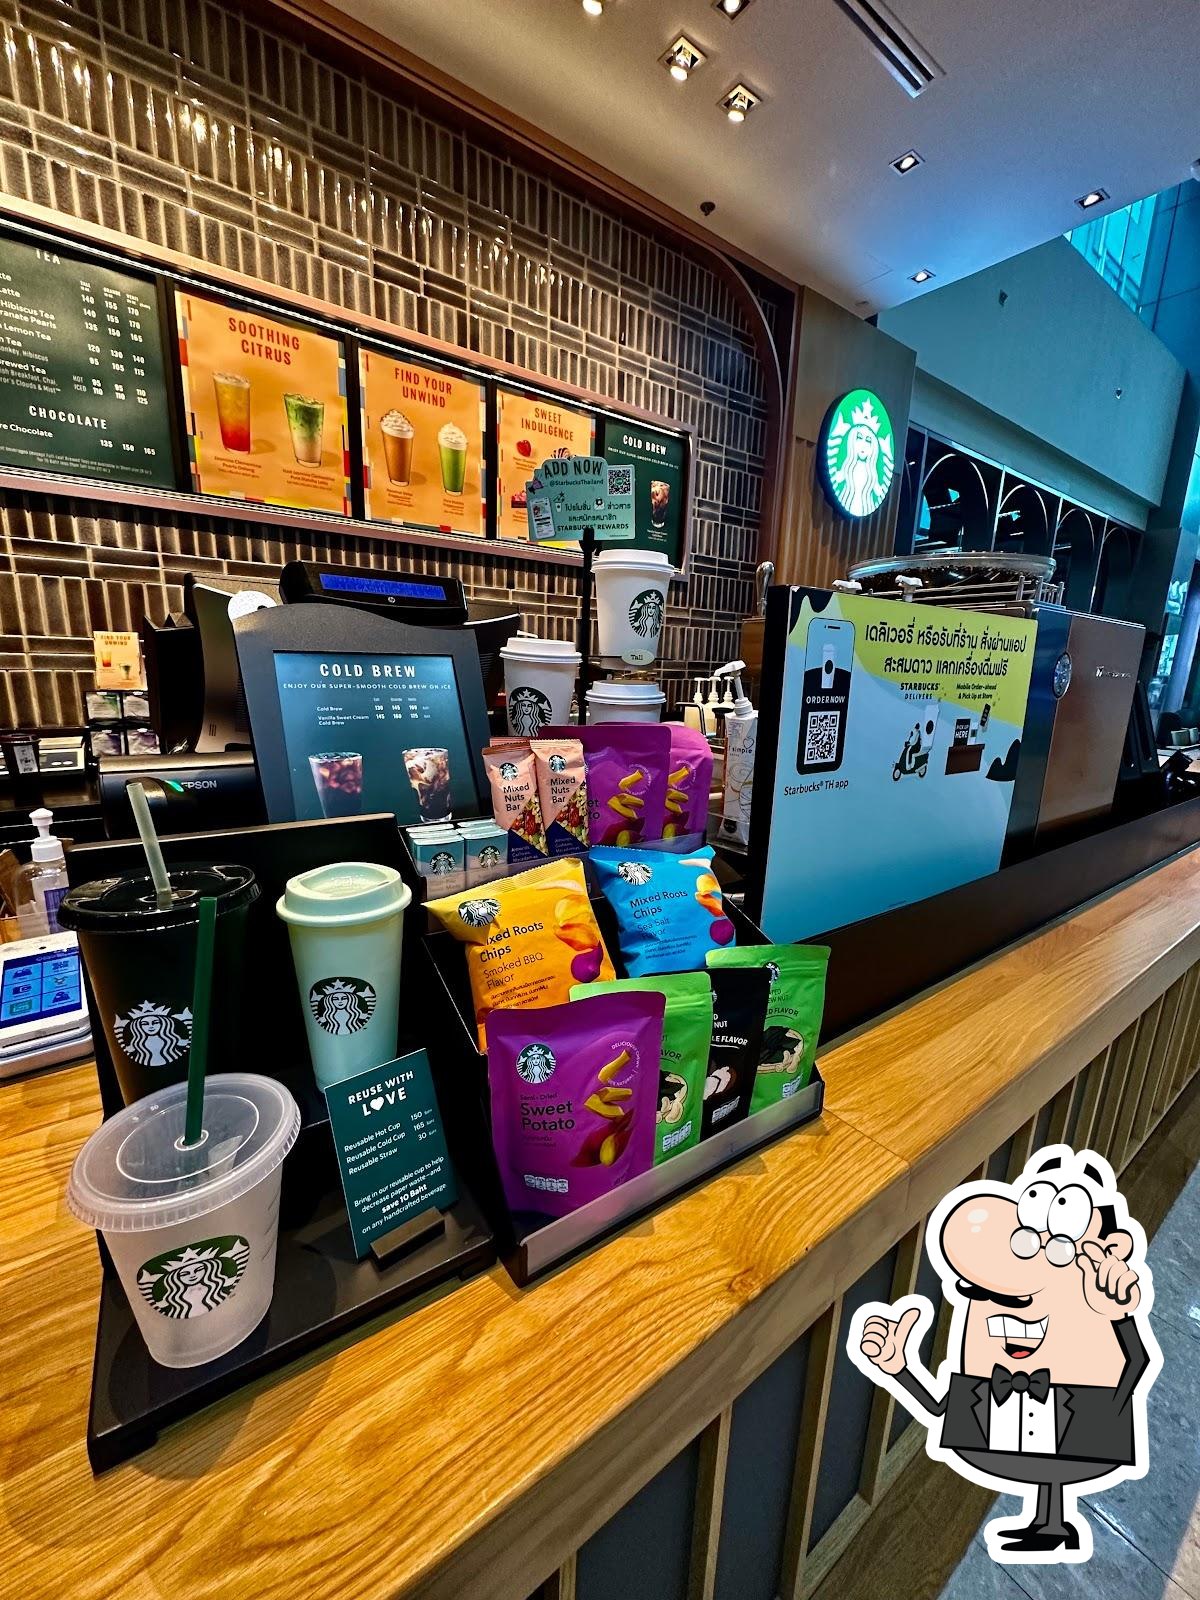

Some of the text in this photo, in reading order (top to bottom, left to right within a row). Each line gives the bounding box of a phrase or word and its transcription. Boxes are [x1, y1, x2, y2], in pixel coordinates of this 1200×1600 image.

[1, 300, 140, 329] Hibiscus Tea 140 155 170
[81, 294, 94, 304] 140
[105, 301, 117, 310] 155
[128, 307, 139, 316] 170
[31, 316, 143, 343] Pearls 135 150 165
[229, 317, 300, 350] SOOTHING
[4, 323, 34, 337] Lemon
[35, 331, 52, 341] Tea
[88, 344, 100, 353] 120
[133, 355, 144, 364] 140
[241, 339, 291, 365] CITRUS
[5, 337, 22, 347] Tea
[112, 363, 124, 372] 105
[134, 368, 144, 376] 115
[31, 365, 46, 375] Tea
[394, 368, 452, 395] FIND YOUR
[93, 387, 103, 395] 110
[115, 392, 125, 400] 110
[402, 386, 446, 408] UNWIND
[29, 405, 107, 430] CHOCOLATE
[534, 407, 562, 424] SWEET
[9, 423, 54, 438] Chocolate
[144, 447, 155, 455] 165
[521, 418, 574, 442] INDULGENCE
[623, 435, 667, 455] COLD BREW
[544, 461, 568, 479] ADD
[573, 459, 603, 476] NOW
[319, 663, 416, 678] COLD BREW
[955, 731, 969, 739] HERE
[503, 782, 530, 793] Mixed
[550, 776, 576, 786] Mixed
[551, 786, 570, 795] Nuts
[825, 780, 835, 790] TH
[835, 779, 849, 789] app
[504, 793, 525, 802] Nuts
[506, 803, 521, 812] Bar
[552, 796, 566, 804] Bar
[630, 890, 688, 908] Mixed Roots
[633, 905, 662, 919] Chips
[486, 922, 544, 945] ixed Roots
[480, 945, 511, 962] Chips
[483, 952, 544, 978] Smoked BBQ
[486, 974, 514, 989] Flavor
[774, 1007, 799, 1016] FLAVOR
[721, 1036, 748, 1046] FLAVOR
[348, 1070, 414, 1104] REUSE WITH
[520, 1101, 573, 1116] Sweet
[344, 1111, 422, 1152] Reusable Hot Cup 150
[521, 1117, 575, 1131] Potato
[346, 1145, 376, 1163] Reusable
[377, 1137, 392, 1149] Cold
[392, 1132, 406, 1142] Cup
[413, 1121, 425, 1131] 165
[348, 1132, 427, 1175] Reusable Straw 30
[354, 1194, 371, 1207] Bring
[371, 1190, 378, 1198] in
[378, 1185, 388, 1194] our
[389, 1172, 414, 1189] reusable
[414, 1166, 424, 1176] cup
[431, 1156, 444, 1166] help
[361, 1184, 408, 1213] decrease paper
[381, 1183, 428, 1213] save 10 Baht
[361, 1225, 371, 1234] on
[371, 1218, 383, 1228] any
[383, 1197, 420, 1221] handcrafted
